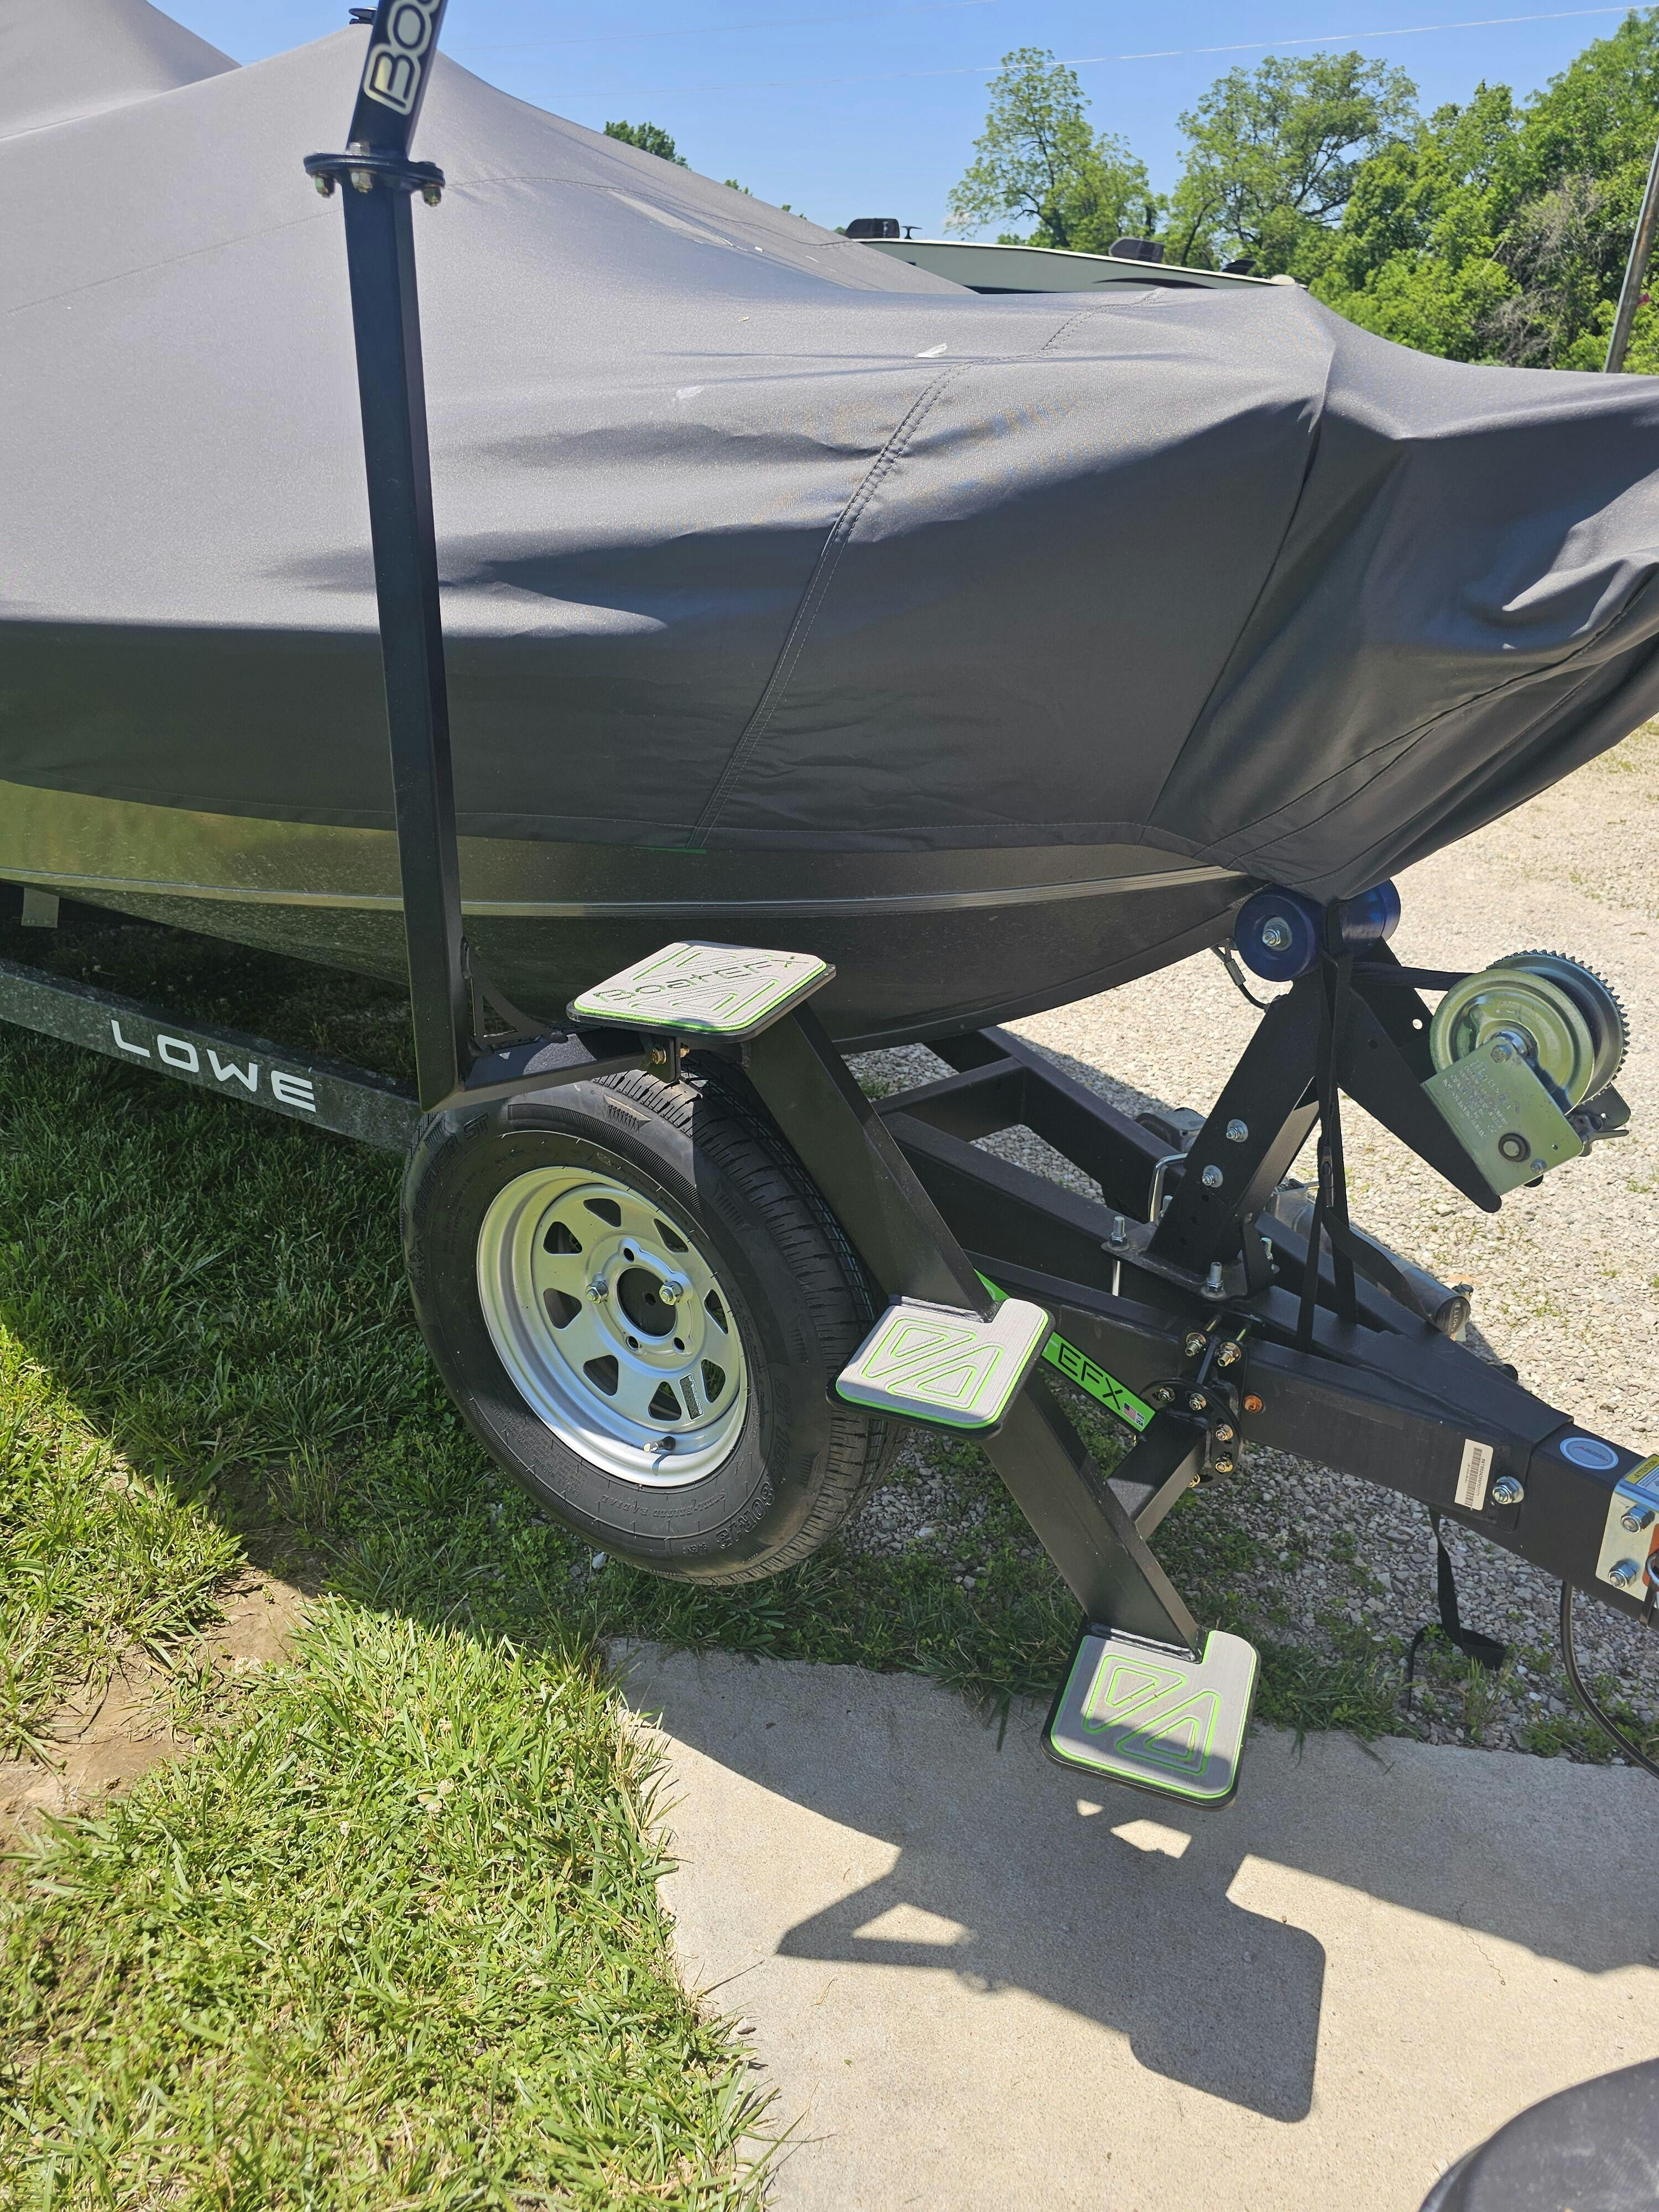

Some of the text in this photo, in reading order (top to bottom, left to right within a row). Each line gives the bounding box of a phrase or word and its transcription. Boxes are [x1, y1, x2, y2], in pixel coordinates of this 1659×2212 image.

[364, 0, 440, 115] BO
[111, 1019, 316, 1113] LOWE
[463, 1112, 488, 1141] ST
[1058, 1343, 1123, 1410] EFX
